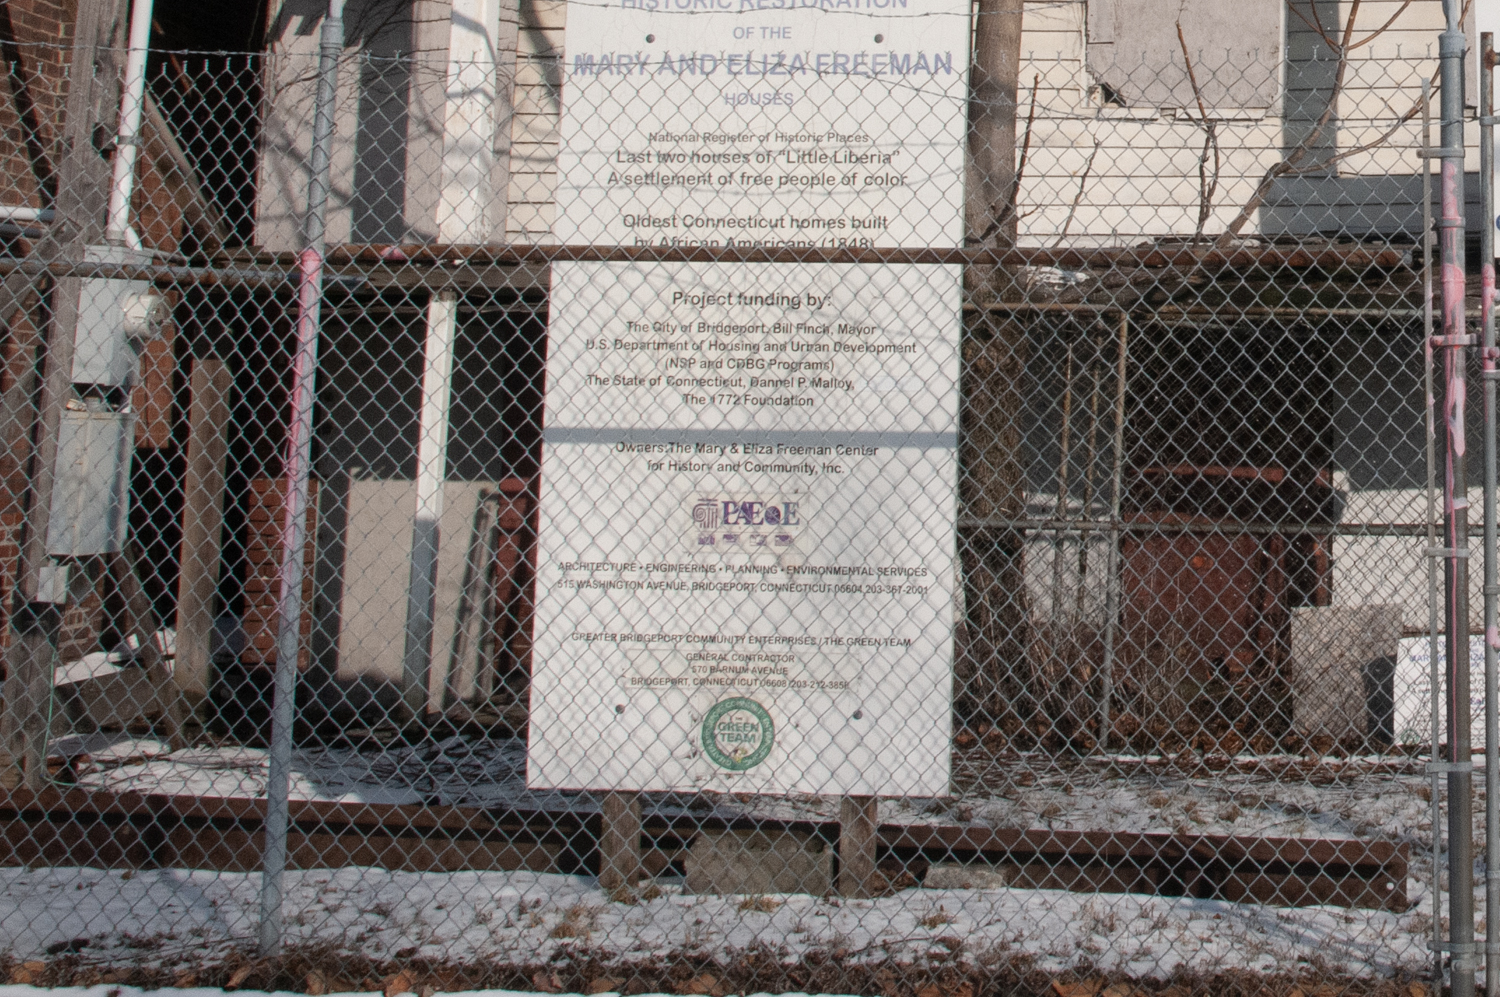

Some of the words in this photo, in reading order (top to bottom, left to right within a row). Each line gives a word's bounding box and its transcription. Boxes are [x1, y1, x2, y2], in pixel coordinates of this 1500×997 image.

[732, 26, 755, 40] OF
[759, 26, 792, 39] THE
[573, 54, 650, 76] MARY
[657, 54, 718, 76] AND
[727, 54, 807, 76] ELIZA
[816, 53, 952, 76] FREEMAN
[724, 92, 794, 106] HOUSES
[649, 132, 699, 142] National
[704, 132, 756, 145] Register
[759, 132, 771, 143] of
[775, 132, 823, 143] Historic
[827, 132, 870, 143] Places
[616, 150, 652, 164] Last
[657, 151, 686, 164] two
[691, 150, 751, 164] houses
[756, 150, 772, 164] of
[607, 172, 619, 185] A
[624, 172, 713, 185] settlement
[717, 172, 734, 185] of
[740, 172, 773, 185] free
[778, 173, 836, 189] people
[841, 172, 858, 186] of
[863, 172, 908, 186] color
[623, 214, 678, 228] Oldest
[682, 214, 785, 229] Connecticut
[790, 215, 846, 229] homes
[851, 215, 888, 230] built
[634, 236, 653, 247] by
[659, 236, 719, 247] African
[726, 237, 815, 248] Americans
[672, 291, 733, 309] Project
[738, 291, 802, 310] funding
[807, 293, 832, 310] by:
[627, 321, 649, 333] The
[652, 321, 678, 336] City
[681, 321, 693, 333] of
[773, 323, 792, 335] Bill
[797, 323, 834, 336] Finch,
[837, 324, 877, 338] Mayor
[586, 339, 610, 350] U.S.
[614, 339, 689, 353] Department
[692, 339, 705, 351] of
[708, 340, 760, 354] Housing
[764, 340, 787, 352] and
[791, 341, 830, 353] Urban
[834, 341, 917, 356] Development
[665, 358, 696, 371] (NSP
[700, 358, 723, 370] and
[726, 358, 766, 370] CDBG
[769, 359, 835, 373] Programs)
[587, 375, 610, 387] The
[613, 375, 646, 387] State
[649, 375, 662, 387] of
[666, 375, 747, 389] Connecticut,
[750, 376, 794, 388] Dannel
[797, 377, 807, 388] P.
[811, 377, 855, 391] Malloy,
[683, 393, 706, 405] The
[710, 394, 740, 406] 1772
[743, 394, 814, 406] Foundation
[695, 442, 726, 457] Mary
[729, 442, 740, 454] &
[743, 442, 773, 455] Eliza
[777, 443, 832, 455] Freeman
[835, 444, 879, 456] Center
[647, 460, 664, 472] for
[668, 460, 711, 474] History
[717, 461, 740, 472] and
[744, 461, 818, 476] Community,
[822, 462, 845, 474] Inc.
[558, 562, 637, 572] ARCHITECTURE
[645, 563, 717, 574] ENGINEERING
[725, 564, 778, 574] PLANNING
[786, 565, 874, 577] ENVIRONMENTAL
[877, 567, 928, 577] SERVICES
[557, 580, 574, 590] 515
[577, 581, 644, 590] WASHINGTON
[646, 581, 689, 592] AVENUE,
[691, 582, 758, 593] BRIDGEPORT,
[760, 583, 832, 594] CONNECTICUT
[571, 632, 618, 643] GREATER
[620, 633, 683, 644] BRIDGEPORT
[686, 634, 746, 645] COMMUNITY
[749, 635, 817, 646] ENTERPRISES
[825, 637, 844, 646] THE
[846, 637, 881, 647] GREEN
[883, 637, 912, 647] TEAM
[686, 652, 729, 662] GENERAL
[731, 653, 795, 663] CONTRACTOR
[718, 722, 759, 732] GREEN
[721, 733, 756, 744] TEAM
